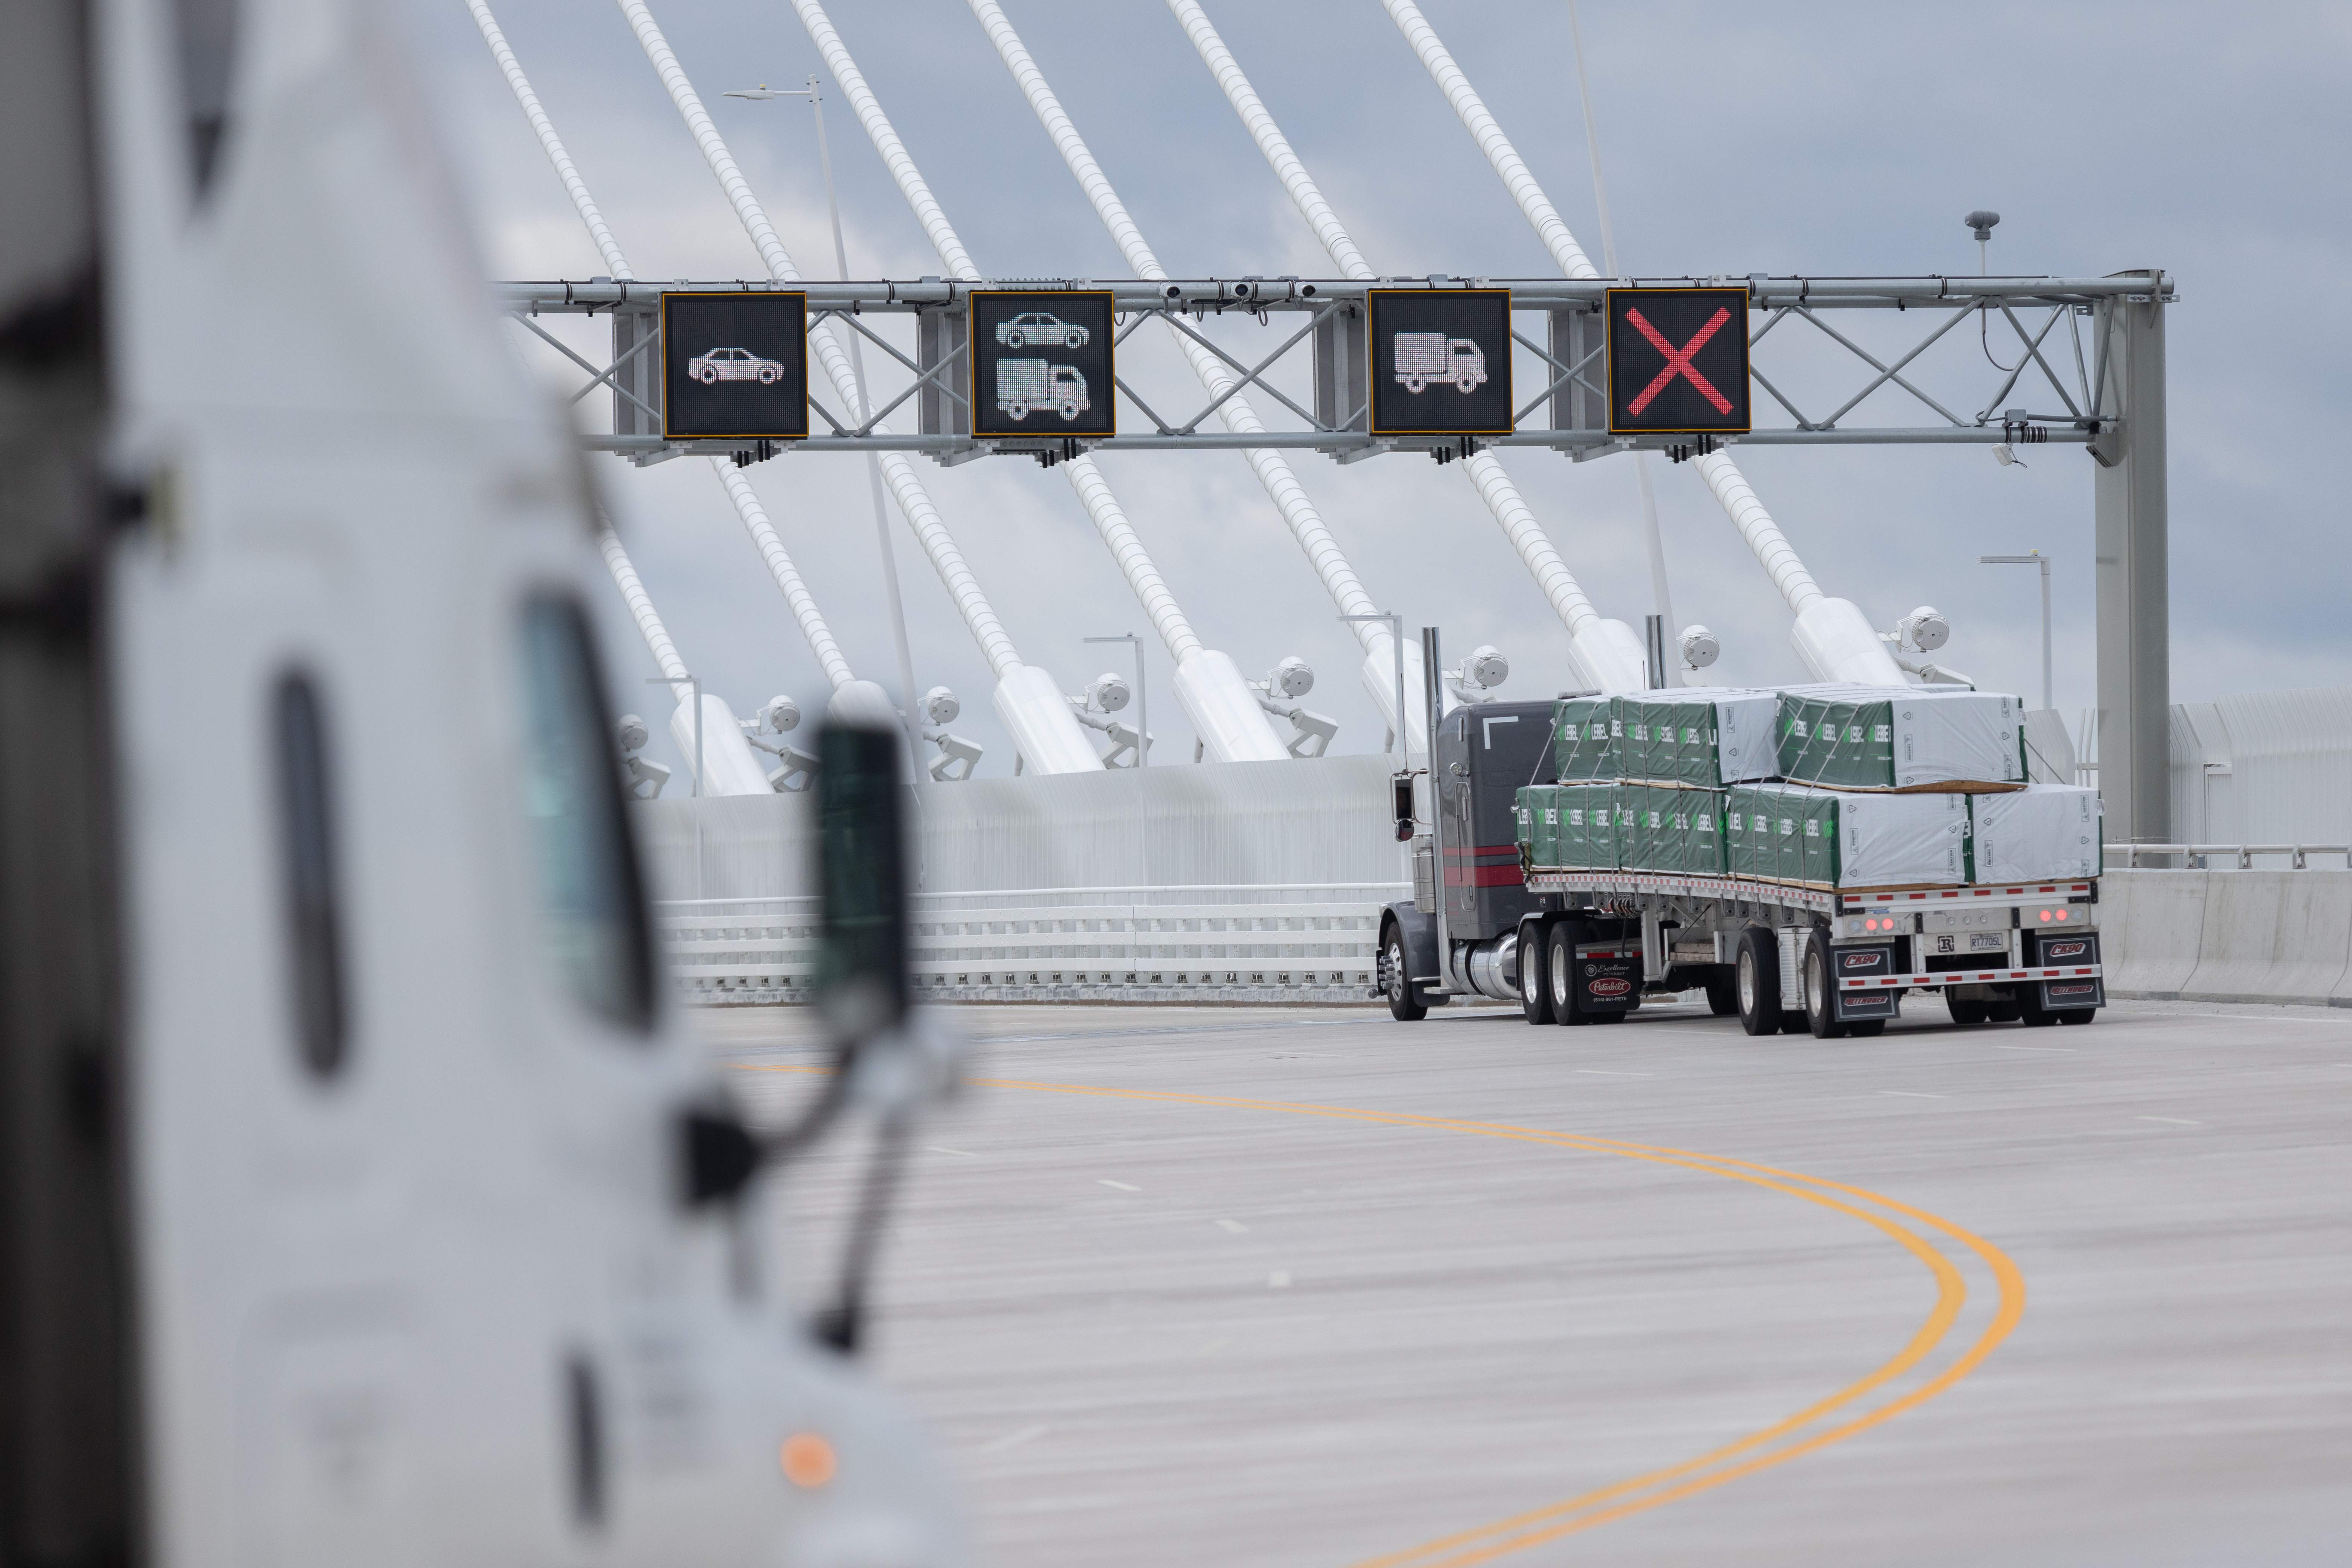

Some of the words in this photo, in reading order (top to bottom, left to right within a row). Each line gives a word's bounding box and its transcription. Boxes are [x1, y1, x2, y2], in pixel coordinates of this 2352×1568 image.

[1972, 937, 2001, 947] RT7705L
[2051, 943, 2085, 956] CK90
[1845, 954, 1880, 967] CK90
[1594, 982, 1628, 992] Peterbilt
